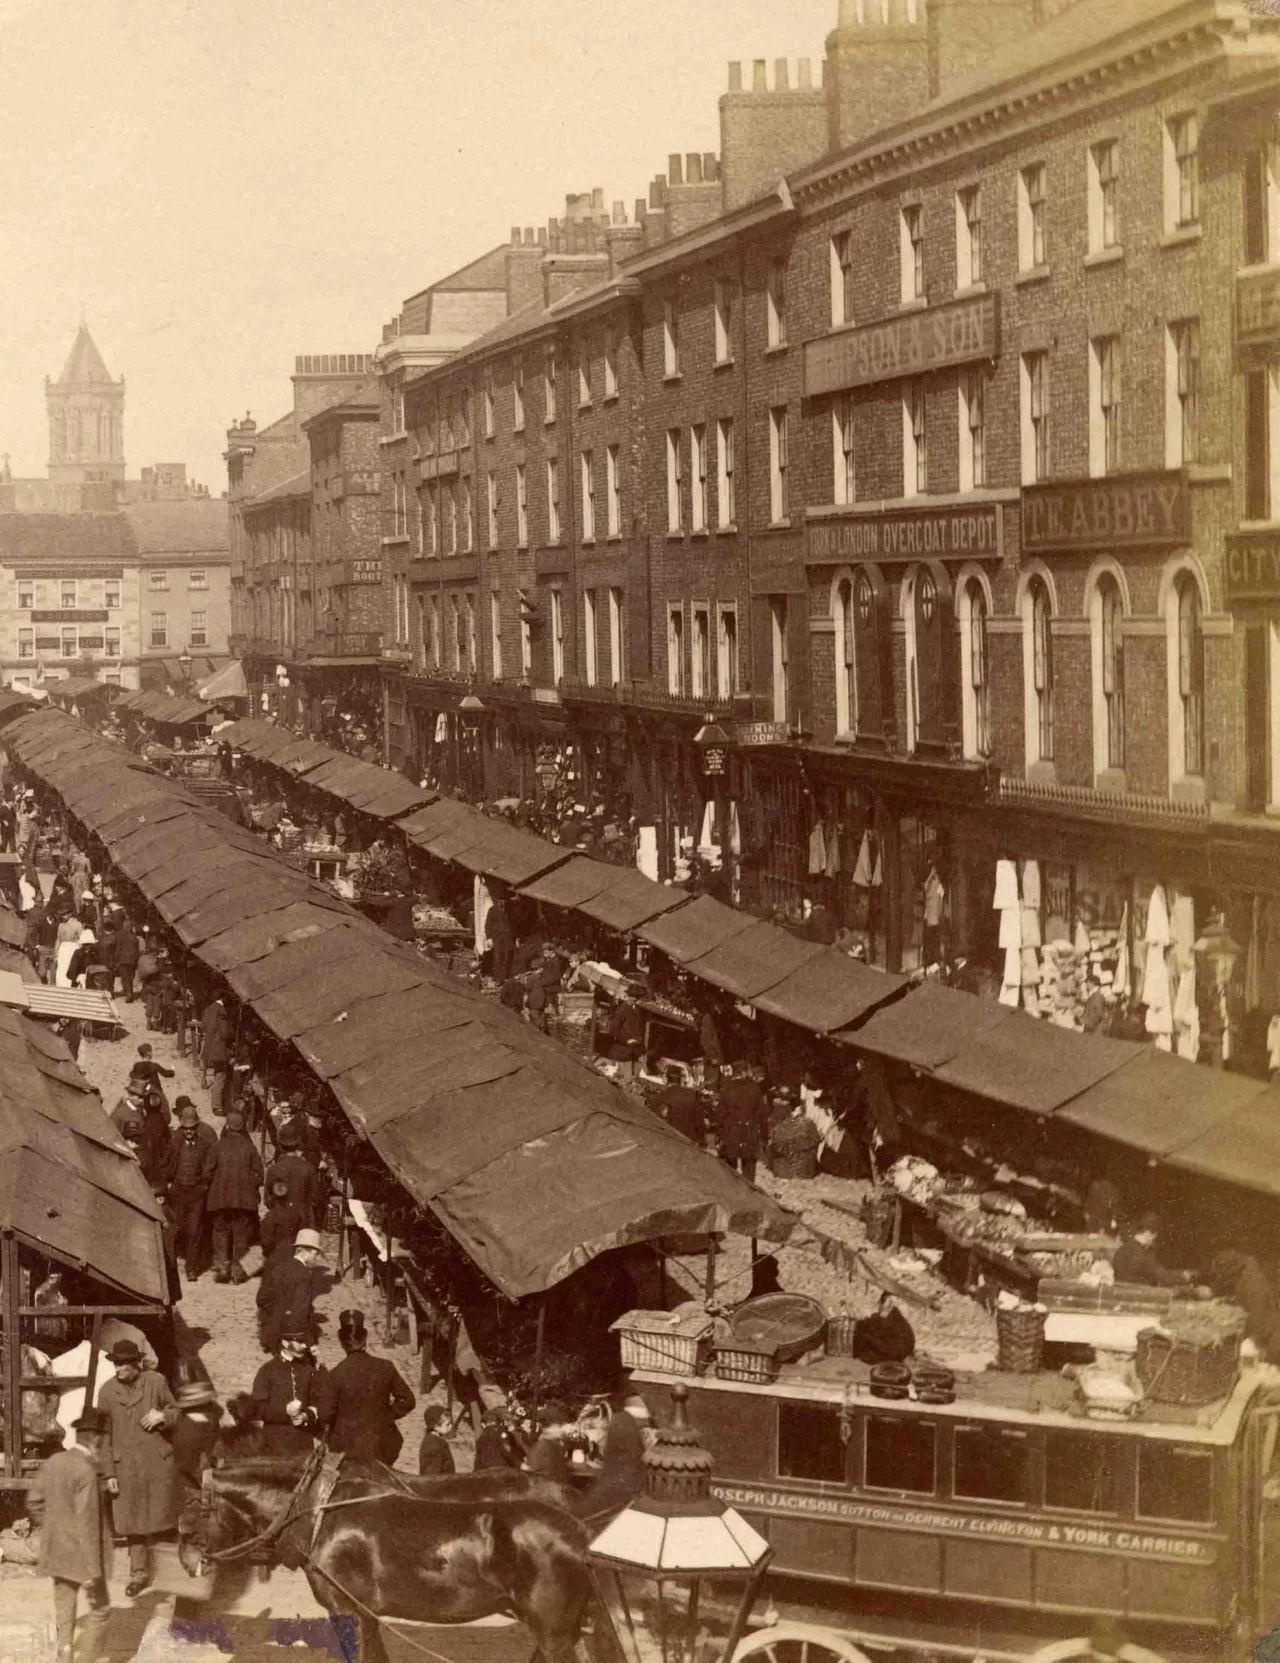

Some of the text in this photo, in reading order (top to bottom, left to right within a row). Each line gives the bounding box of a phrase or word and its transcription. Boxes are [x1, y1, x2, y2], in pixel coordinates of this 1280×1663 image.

[933, 300, 985, 361] SON
[837, 524, 878, 554] LONDON
[883, 519, 947, 553] OVERCOAT
[1069, 484, 1181, 537] ABBEY
[766, 1492, 838, 1513] JACKSON
[840, 1504, 891, 1520] SUTTON
[1048, 1526, 1060, 1541] &
[1063, 1526, 1111, 1546] YORK
